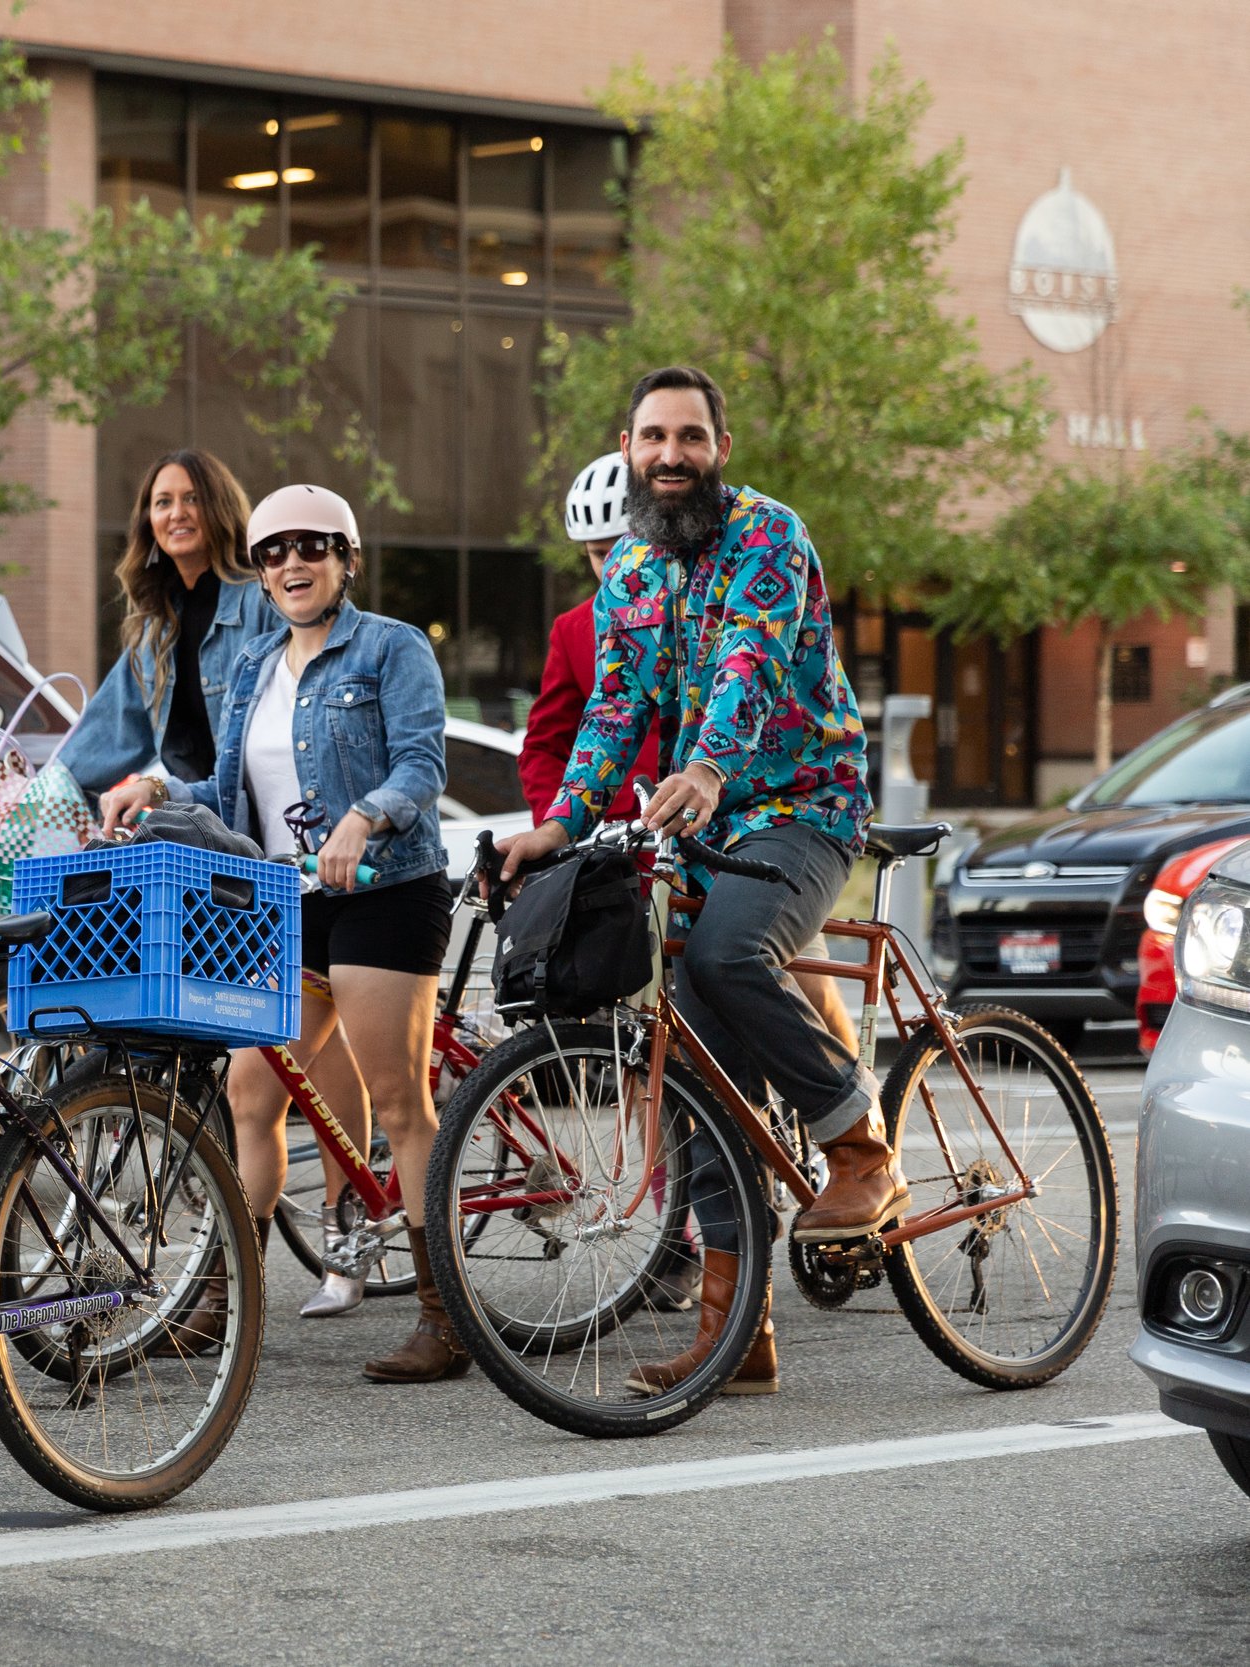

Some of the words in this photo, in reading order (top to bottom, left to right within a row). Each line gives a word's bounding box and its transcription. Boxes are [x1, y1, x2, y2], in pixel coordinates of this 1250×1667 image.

[272, 1045, 304, 1074] RY
[299, 1079, 366, 1171] FISHER
[19, 1306, 60, 1328] Record
[62, 1295, 113, 1318] Exchange
